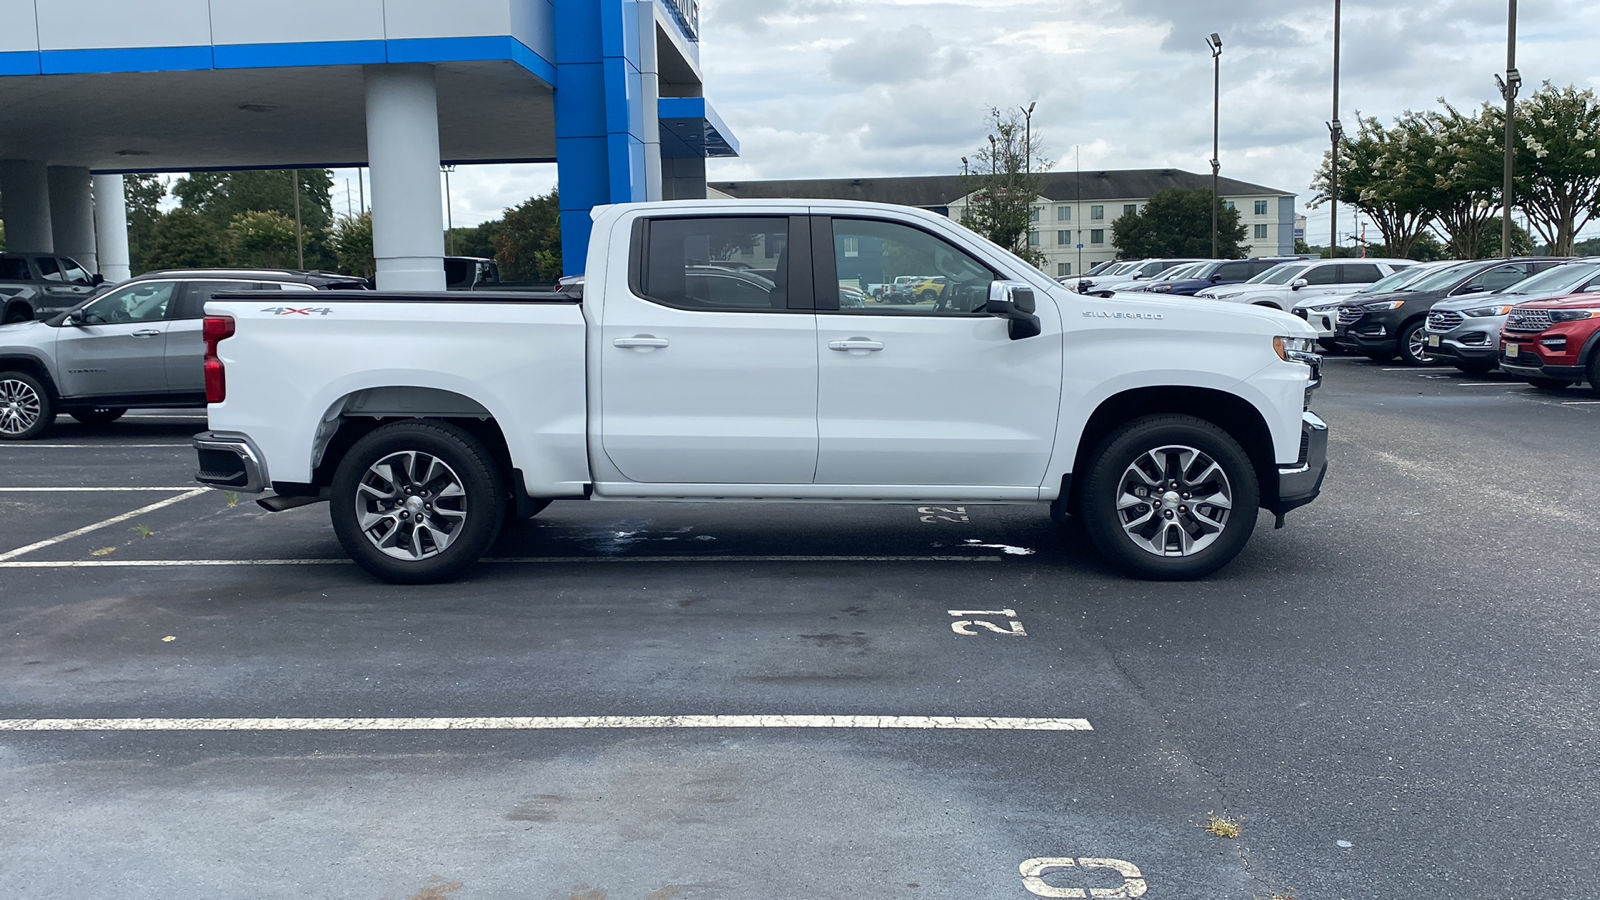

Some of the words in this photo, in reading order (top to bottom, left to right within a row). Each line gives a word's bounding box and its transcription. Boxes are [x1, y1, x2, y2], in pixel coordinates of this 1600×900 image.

[1082, 311, 1164, 321] SILVERADO
[917, 506, 970, 524] 22
[947, 608, 1028, 637] 21
